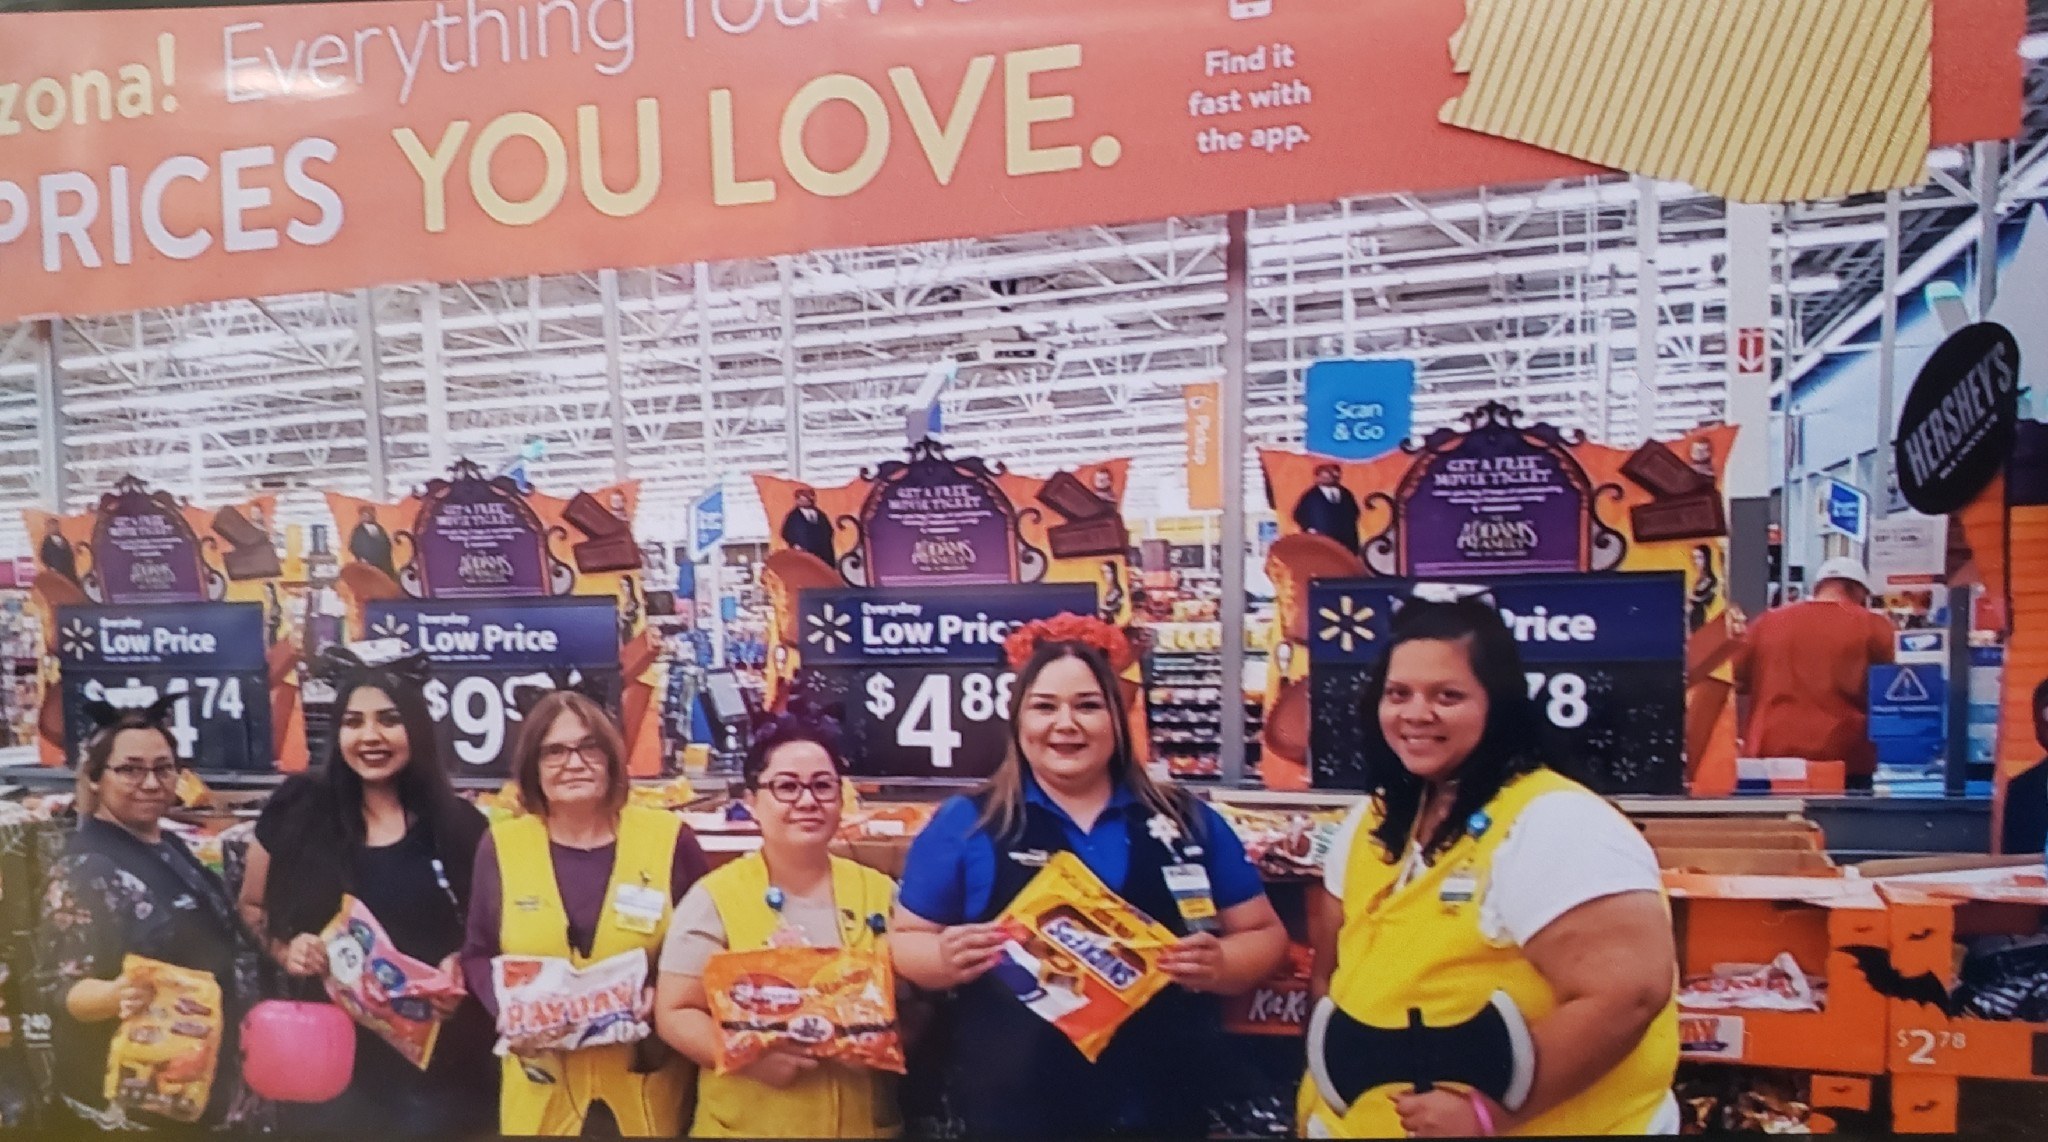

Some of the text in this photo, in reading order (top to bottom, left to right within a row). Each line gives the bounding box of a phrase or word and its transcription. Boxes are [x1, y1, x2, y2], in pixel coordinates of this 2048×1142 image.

[223, 0, 637, 104] Everything
[1204, 43, 1295, 77] Find it
[1188, 79, 1312, 117] fast with
[392, 98, 662, 233] YOU
[709, 44, 1122, 206] LOVE.
[1196, 125, 1311, 154] the app.
[1335, 400, 1384, 420] Scan
[1905, 341, 2014, 488] HERSHEY'S
[1333, 421, 1385, 441] & Go
[100, 625, 218, 653] Low Price
[418, 621, 559, 652] Low Price
[862, 616, 934, 645] Low
